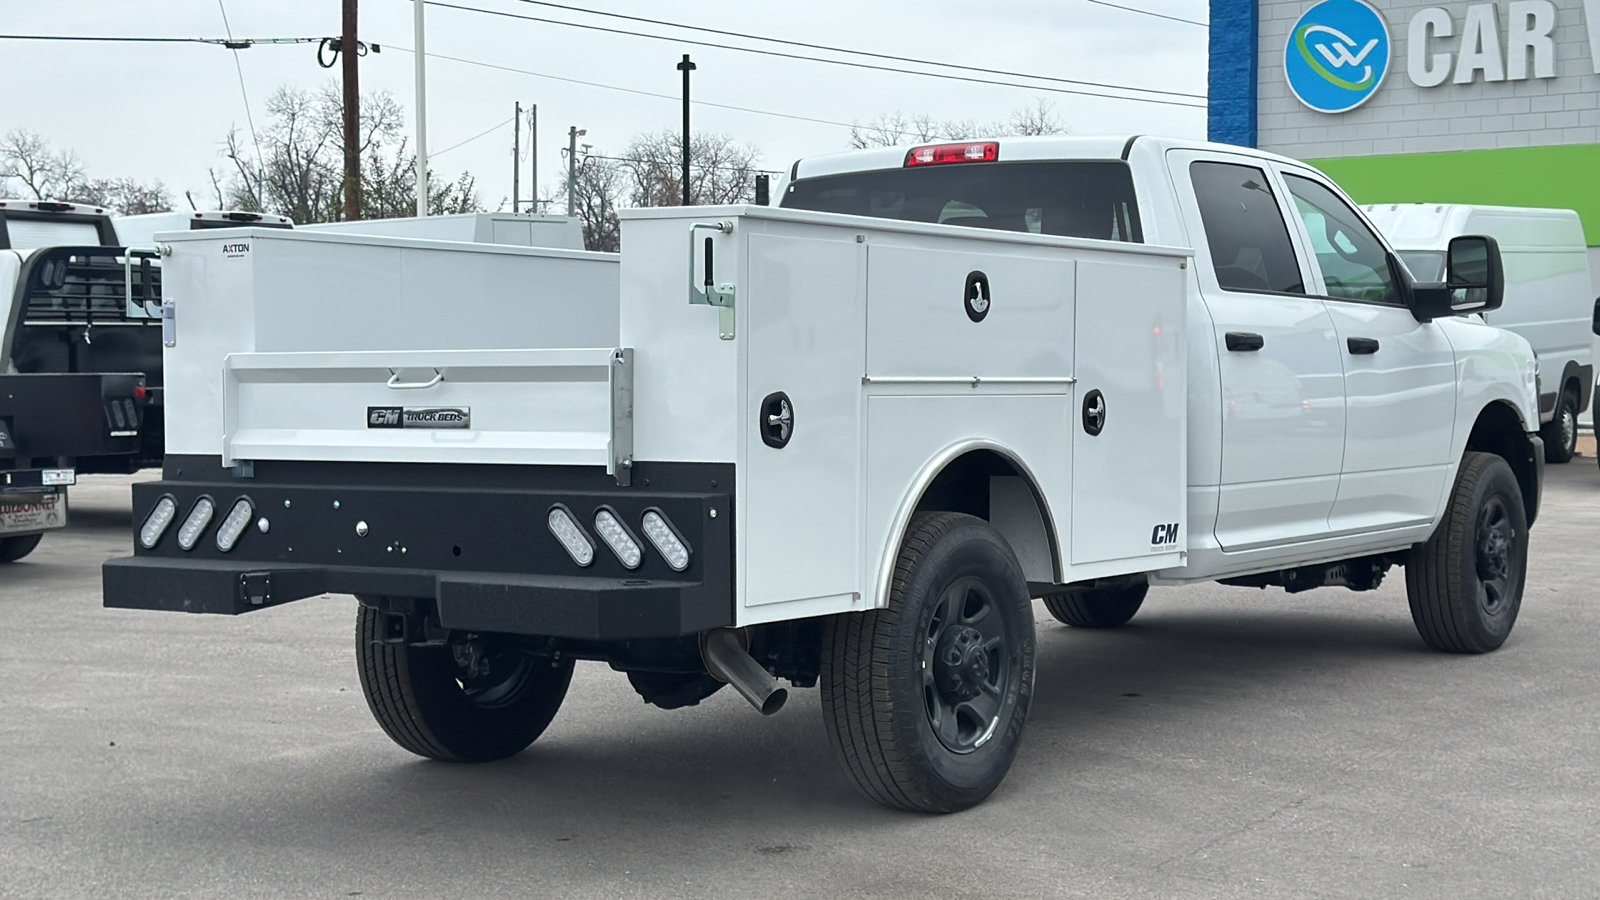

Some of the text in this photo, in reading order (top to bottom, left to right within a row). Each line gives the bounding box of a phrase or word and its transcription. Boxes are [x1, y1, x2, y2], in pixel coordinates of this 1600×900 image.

[1406, 0, 1558, 87] CAR
[222, 243, 249, 253] AXTON
[370, 410, 463, 424] CM TRUCK BEDS
[1151, 523, 1179, 544] CM
